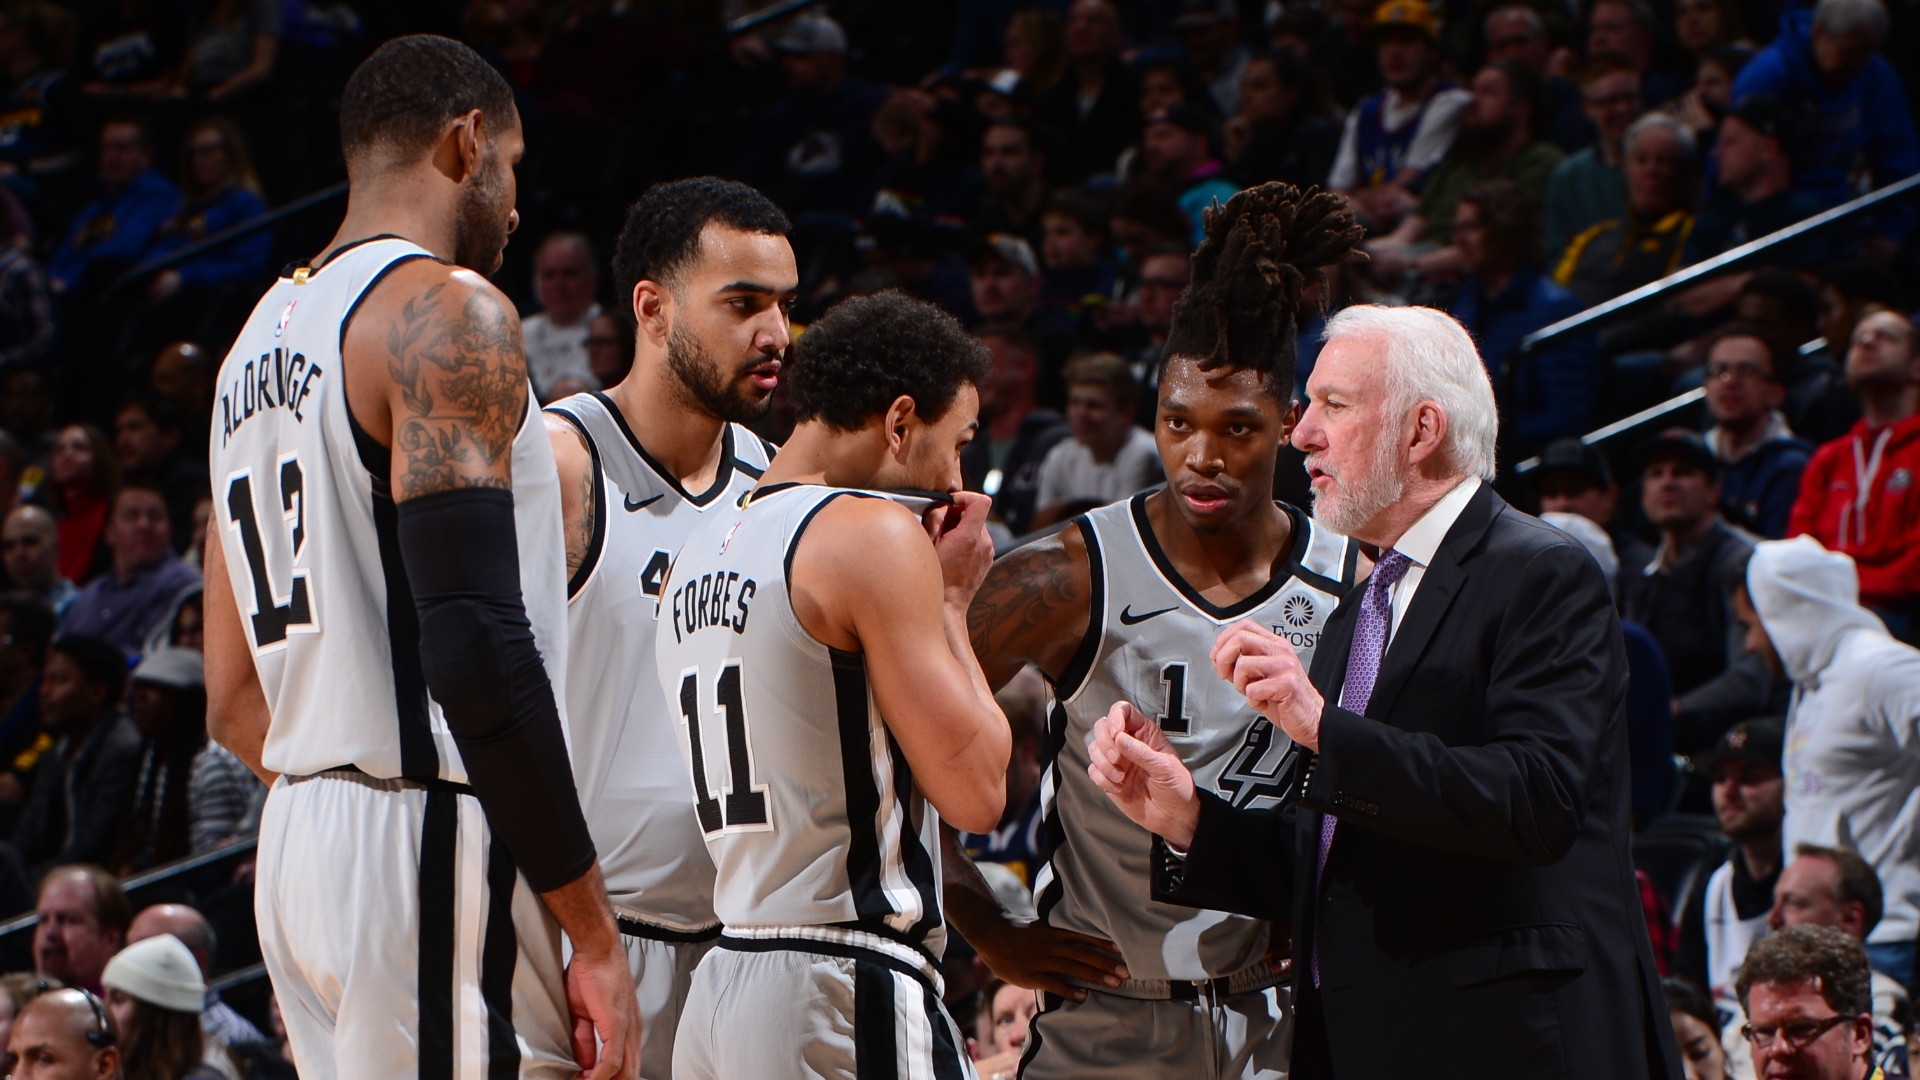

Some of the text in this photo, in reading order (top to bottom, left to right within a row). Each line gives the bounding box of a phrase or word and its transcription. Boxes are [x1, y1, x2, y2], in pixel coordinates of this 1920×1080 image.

[222, 346, 323, 449] ALDRIGE
[673, 571, 757, 644] FORBES
[1156, 661, 1192, 737] 1
[676, 657, 774, 841] 11
